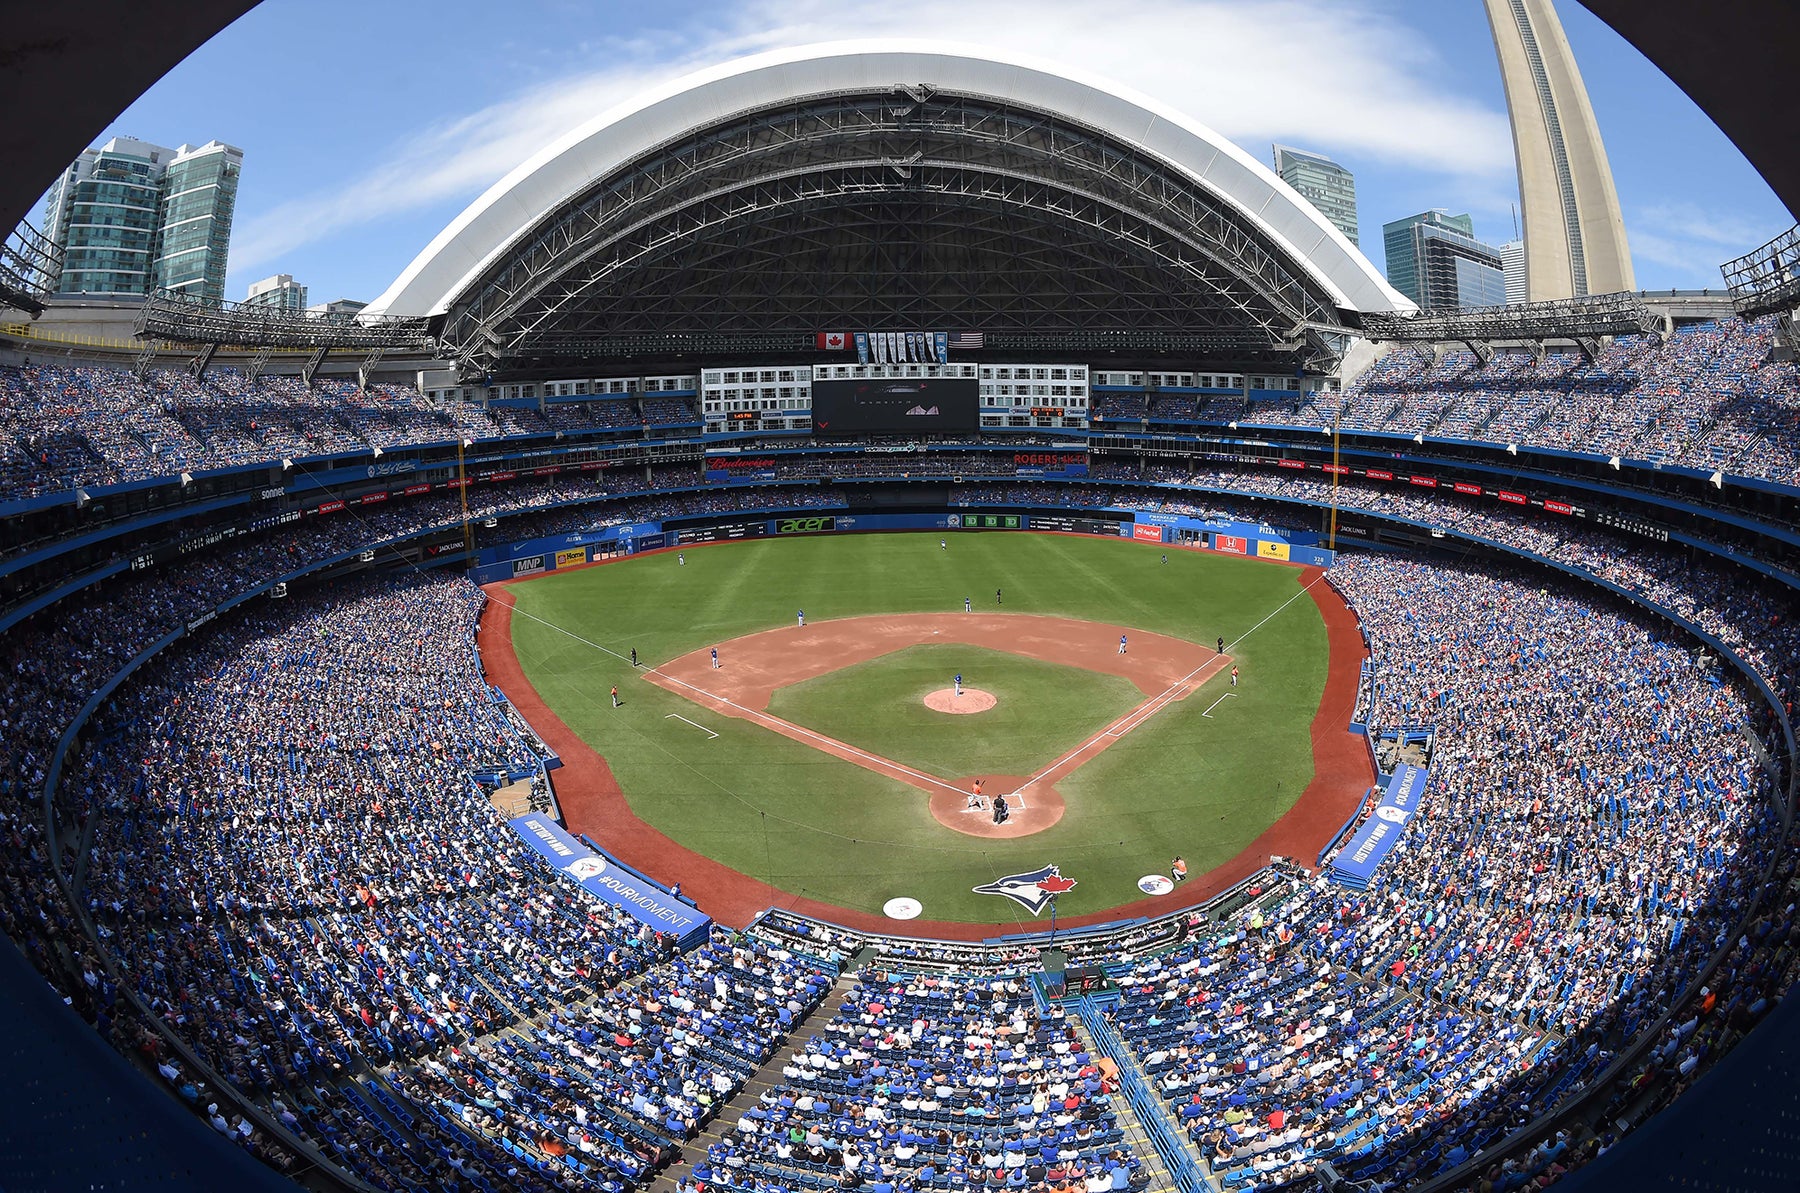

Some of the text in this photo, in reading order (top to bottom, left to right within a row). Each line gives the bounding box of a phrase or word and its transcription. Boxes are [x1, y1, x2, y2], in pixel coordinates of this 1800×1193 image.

[936, 345, 946, 355] 12
[706, 457, 776, 470] Budweiser
[1013, 454, 1058, 465] ROGERS
[261, 486, 285, 500] sonnet
[780, 517, 830, 533] acer
[966, 516, 977, 525] TD
[986, 517, 997, 526] TD
[1007, 518, 1017, 527] TD
[1259, 526, 1276, 535] PIZZA
[566, 551, 585, 559] Home
[517, 558, 541, 572] MNP
[598, 875, 693, 929] #OURMOMENT
